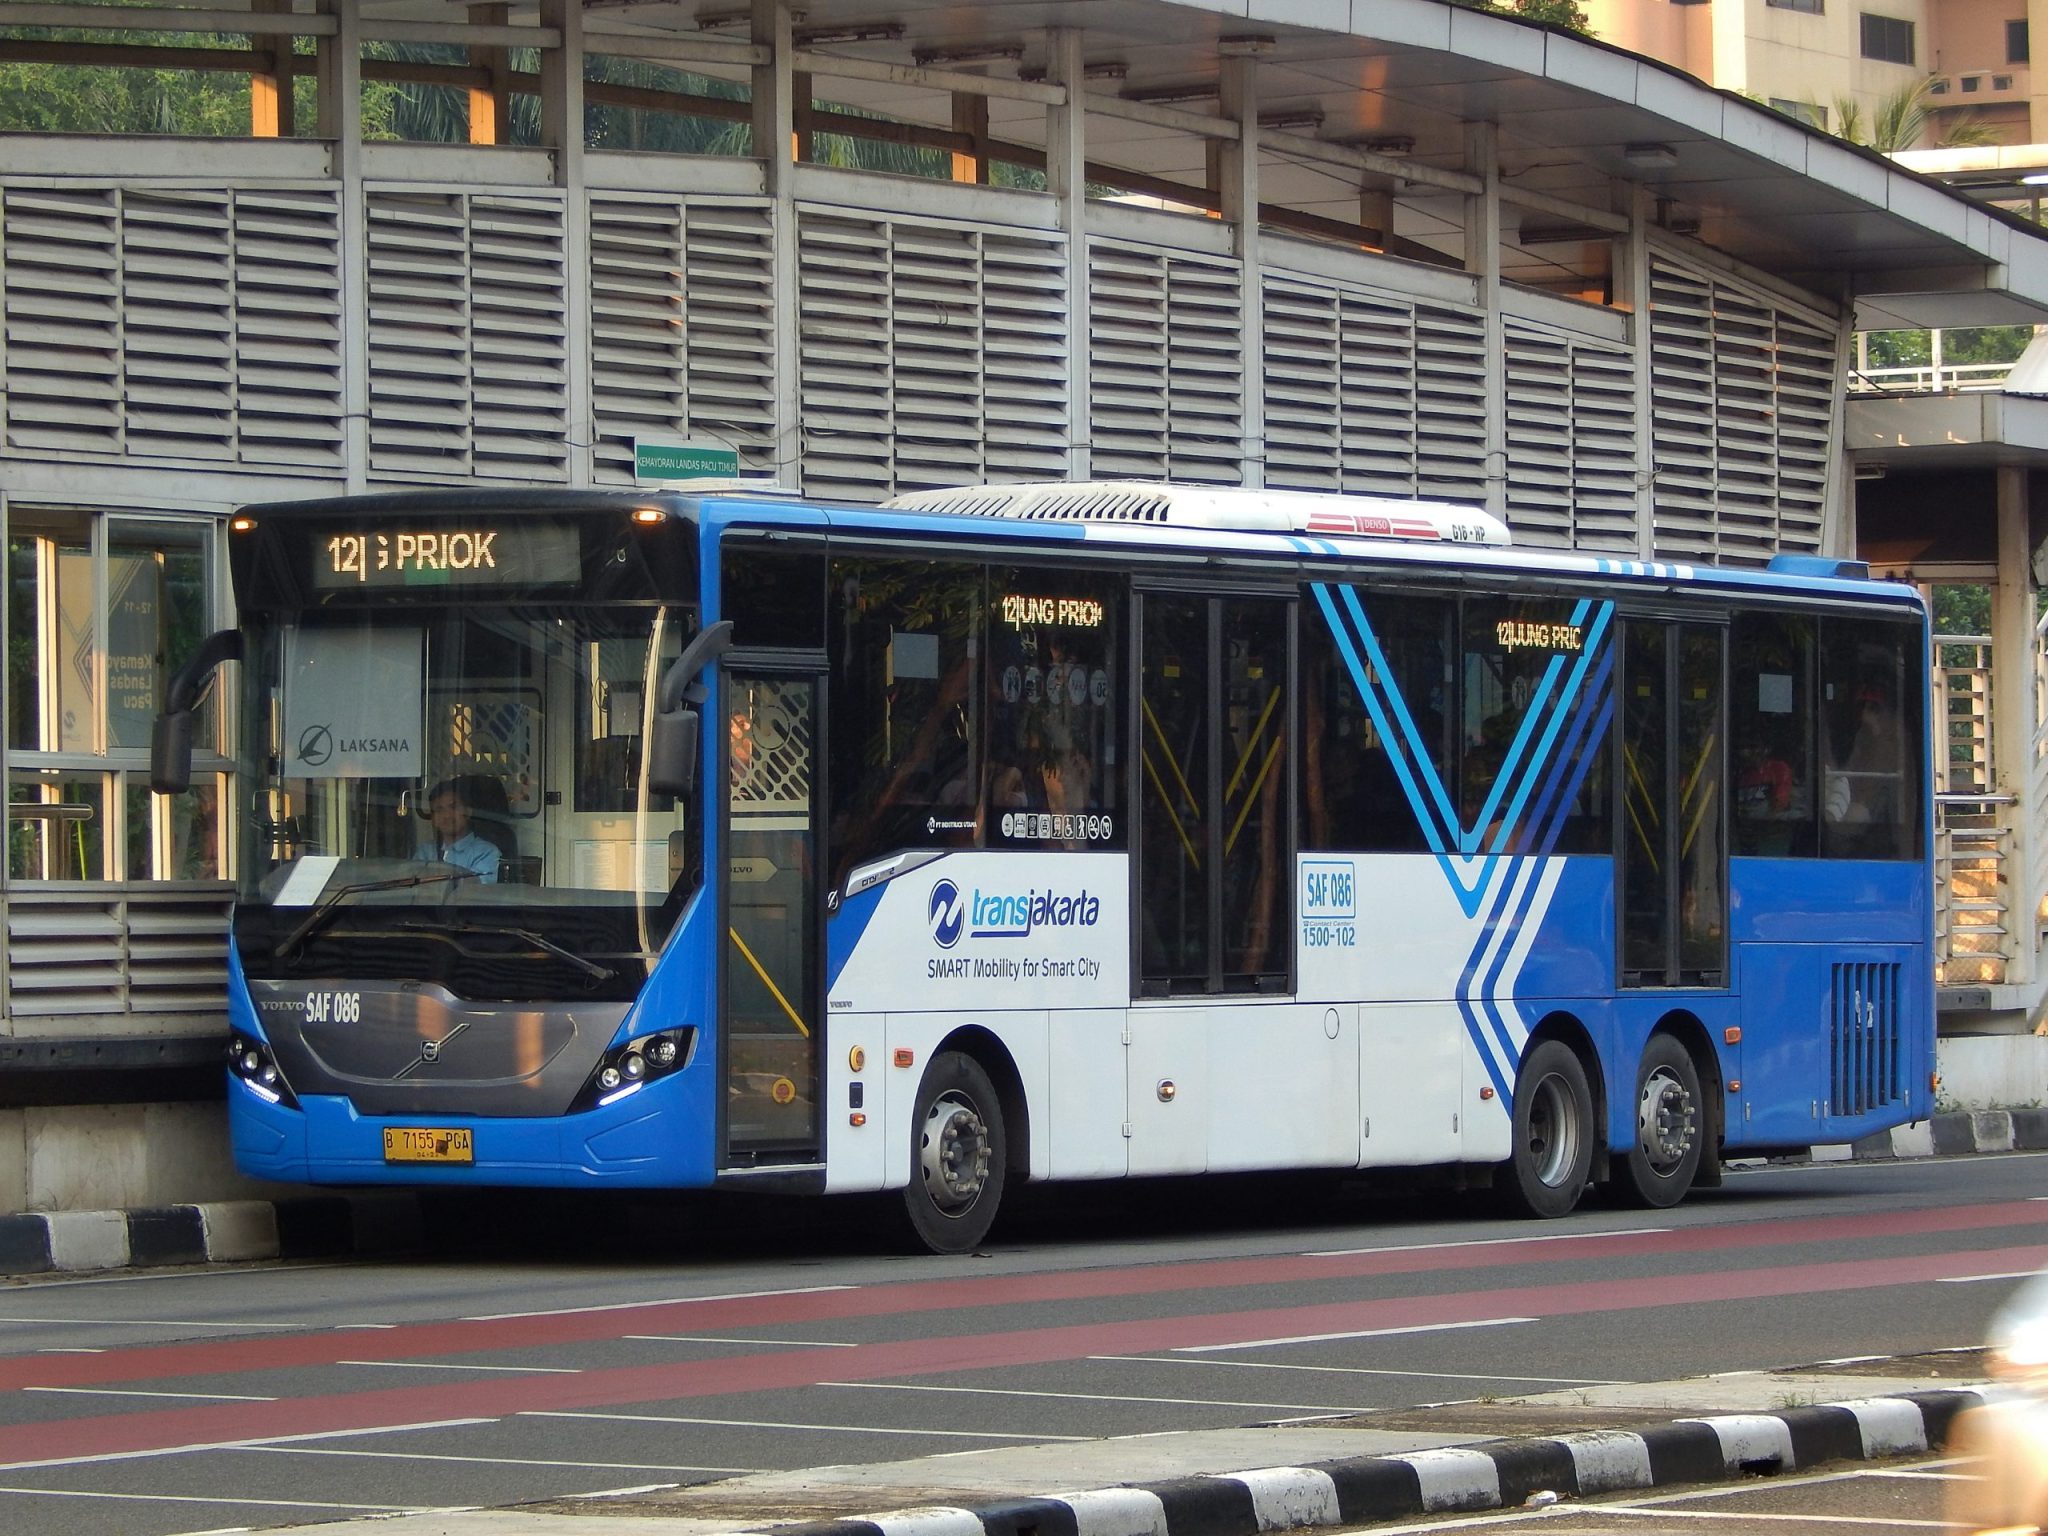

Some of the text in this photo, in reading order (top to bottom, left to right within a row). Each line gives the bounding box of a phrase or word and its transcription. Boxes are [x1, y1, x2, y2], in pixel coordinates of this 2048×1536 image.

[637, 457, 737, 473] KEMAYORAN LANDAS PACU TIMUR
[1364, 519, 1388, 530] DENSO
[397, 533, 498, 570] PRIOK
[340, 739, 409, 752] LAKSANA
[729, 866, 752, 874] LVO
[1307, 873, 1352, 908] SAF 086
[971, 889, 1100, 938] transjakarta
[1303, 926, 1355, 946] 1500-102
[927, 957, 1100, 981] SMART Mobility for Smart City
[261, 1001, 305, 1011] VOLVO
[306, 991, 360, 1023] SAF 086
[385, 1131, 469, 1150] B 7155 PGA
